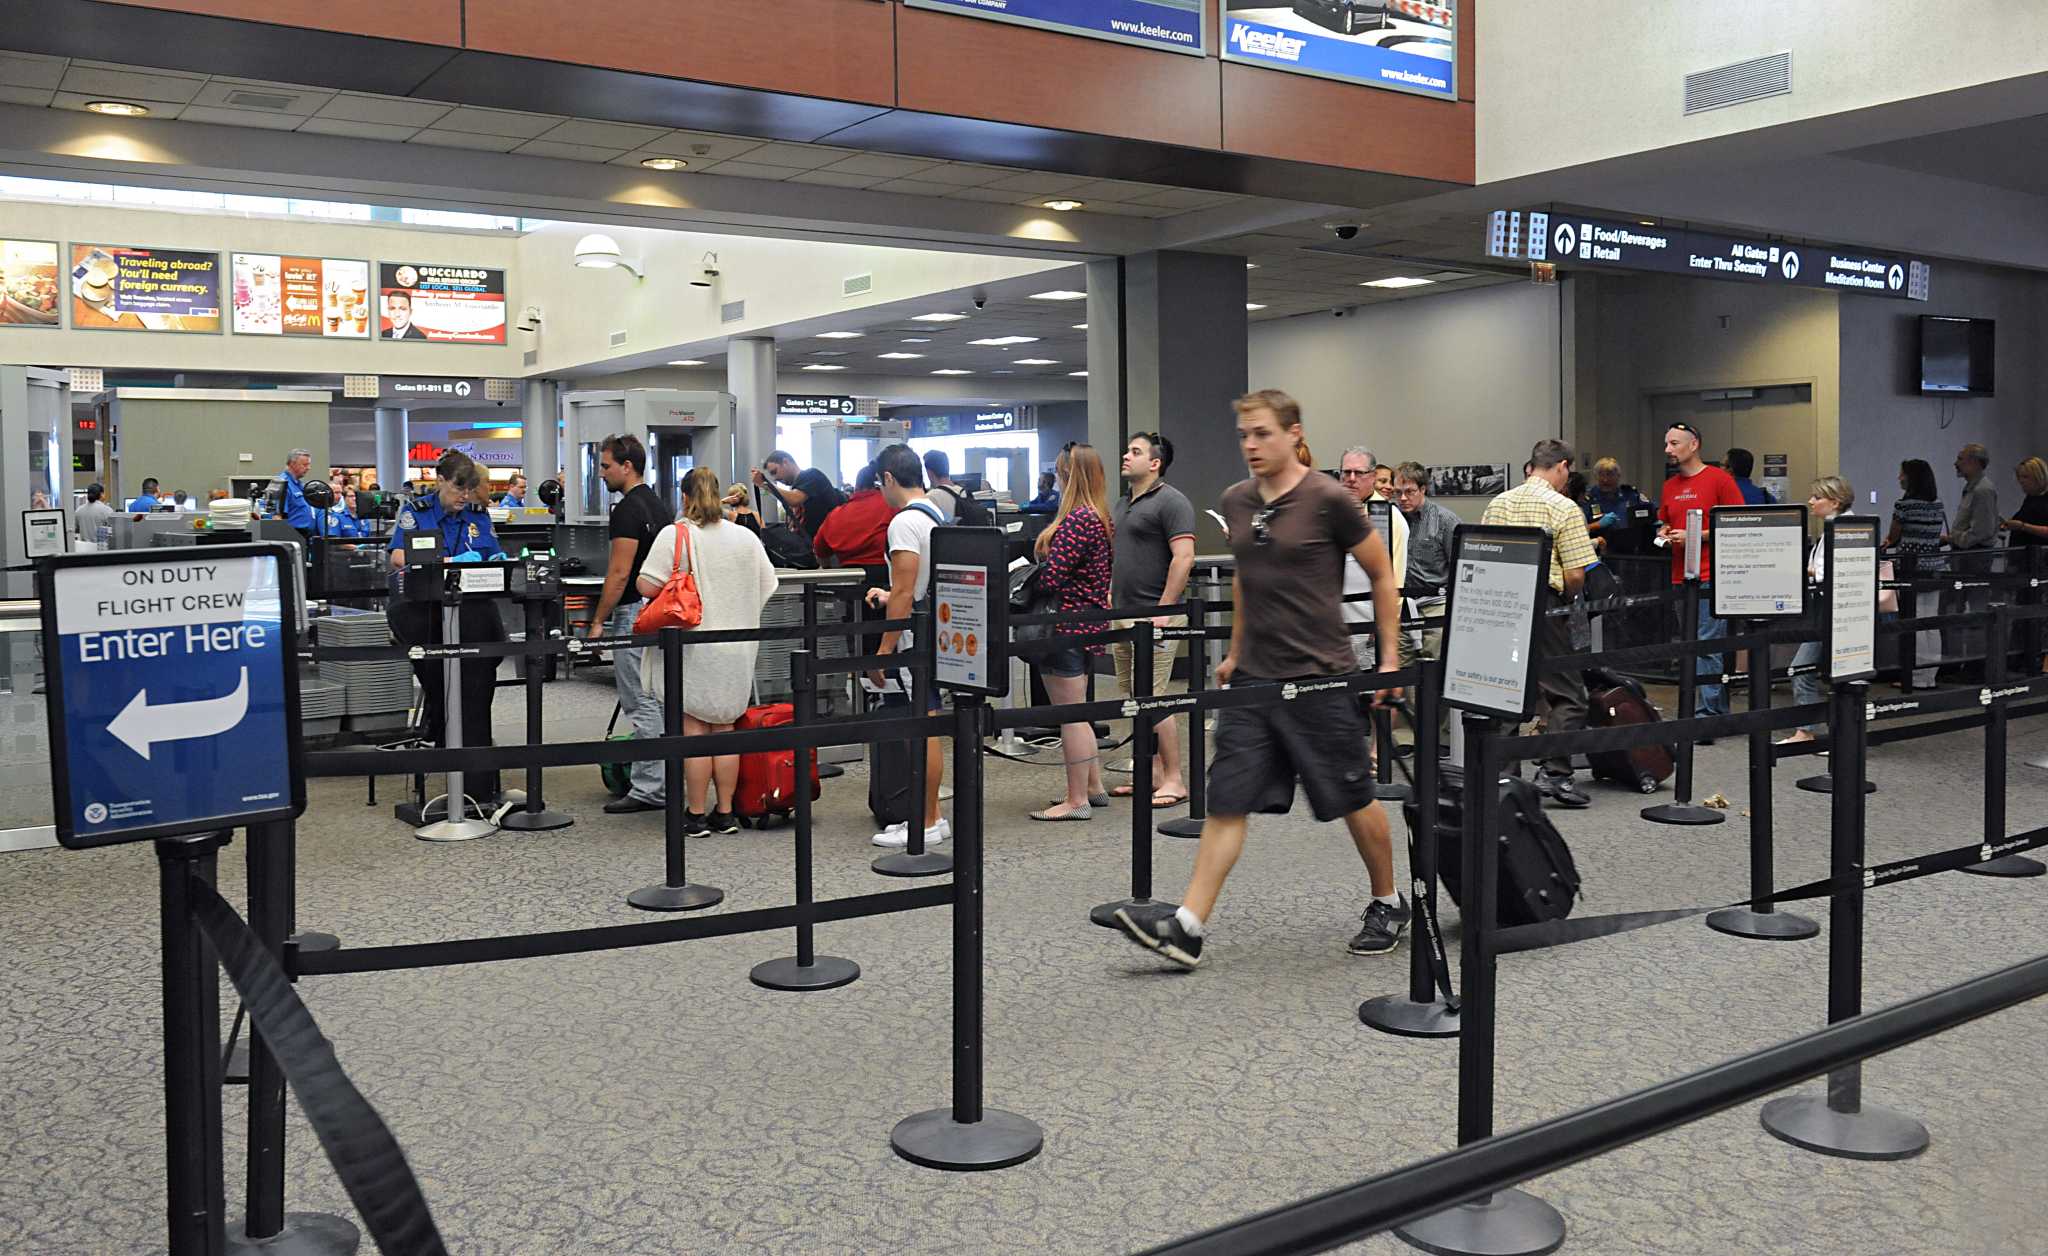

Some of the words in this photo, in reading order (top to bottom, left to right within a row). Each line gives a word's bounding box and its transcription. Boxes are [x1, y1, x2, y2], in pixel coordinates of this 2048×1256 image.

[1111, 19, 1193, 43] www.keeler.com
[1230, 23, 1307, 57] Keeler
[1380, 67, 1447, 89] www.keeler.com
[1594, 227, 1667, 250] Food/Beverages
[1593, 245, 1620, 261] Retail
[1731, 244, 1744, 258] All
[1745, 246, 1768, 260] Gates
[119, 256, 168, 270] Traveling
[170, 260, 213, 271] abroad?
[1689, 254, 1712, 269] Enter
[1713, 257, 1733, 271] Thru
[1734, 259, 1767, 277] Security
[1830, 256, 1861, 271] Business
[1861, 260, 1886, 274] Center
[119, 268, 149, 280] You'll
[151, 271, 178, 281] need
[419, 267, 487, 279] GUCCIARDO
[1825, 271, 1863, 287] Meditation
[1863, 276, 1884, 289] Room
[119, 280, 158, 292] foreign
[160, 282, 208, 295] currency.
[480, 452, 514, 461] KITCHEN
[1464, 542, 1480, 552] Travel
[1480, 544, 1504, 554] Advisory
[123, 569, 155, 586] ON
[161, 566, 217, 584] DUTY
[97, 596, 175, 617] FLIGHT
[182, 592, 244, 611] CREW
[79, 628, 174, 664] Enter
[185, 623, 265, 653] Here
[1140, 702, 1158, 710] Capital
